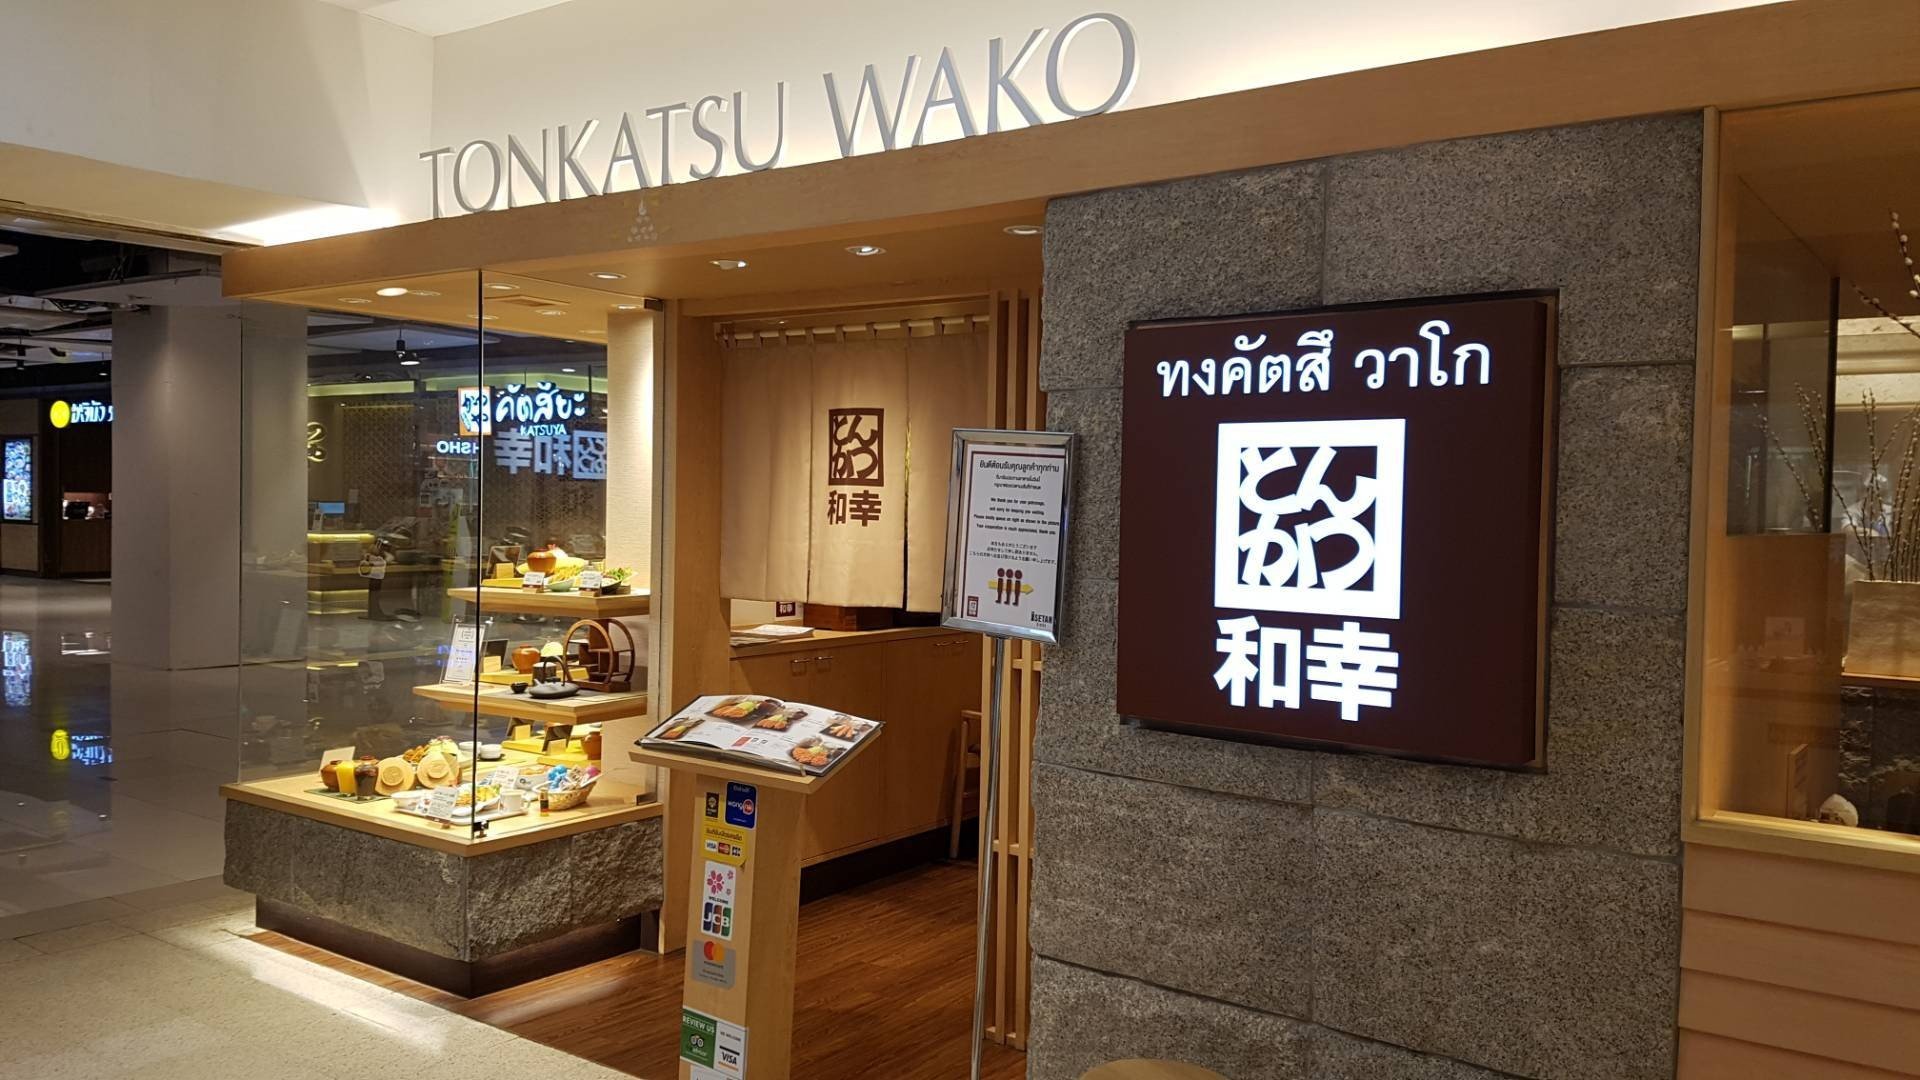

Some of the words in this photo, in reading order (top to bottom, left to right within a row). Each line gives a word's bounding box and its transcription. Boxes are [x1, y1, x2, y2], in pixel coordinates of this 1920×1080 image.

[420, 81, 790, 219] TONKATSU
[823, 12, 1139, 158] WAKO
[1157, 328, 1334, 397] ทงคัตสึ
[1354, 319, 1491, 389] วาโก
[520, 424, 567, 436] KATSUYA
[828, 490, 881, 527] 和幸
[1213, 615, 1399, 722] 和幸
[703, 909, 730, 929] JCB
[682, 1015, 705, 1030] REVIEW
[706, 1024, 715, 1033] US
[722, 1051, 737, 1065] VISA
